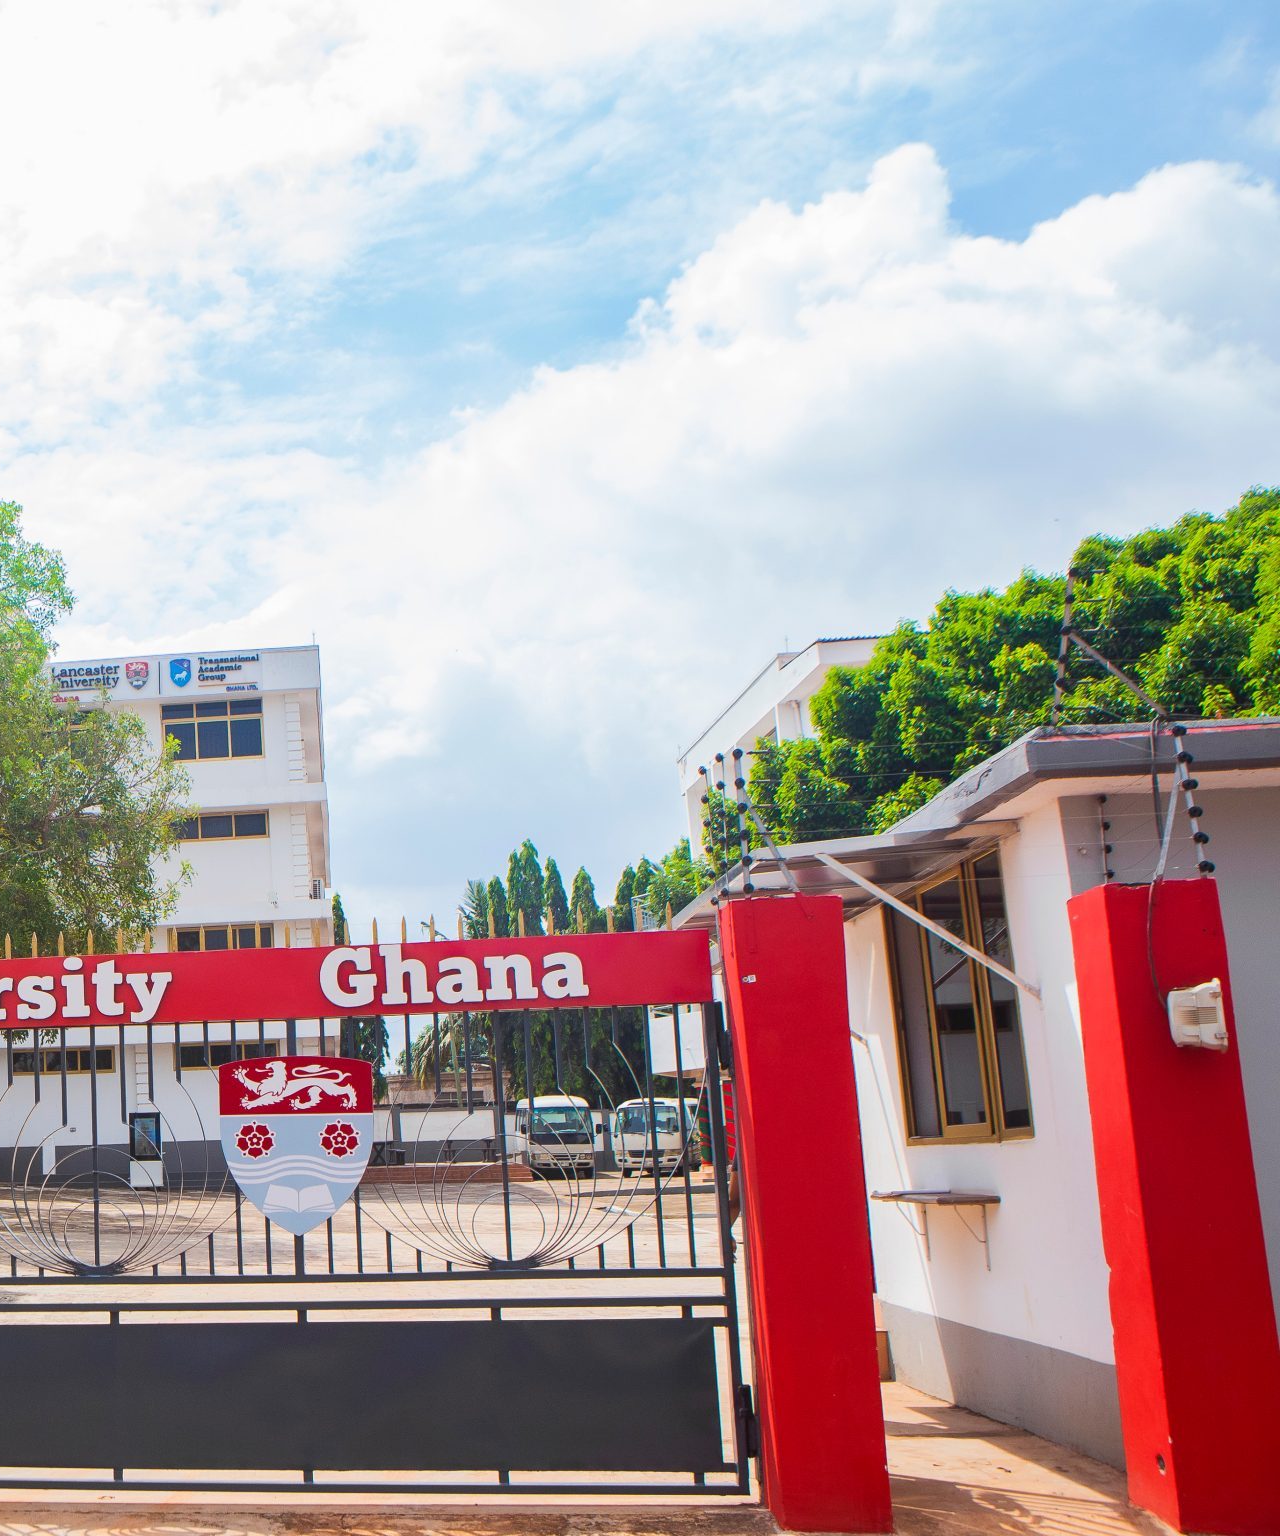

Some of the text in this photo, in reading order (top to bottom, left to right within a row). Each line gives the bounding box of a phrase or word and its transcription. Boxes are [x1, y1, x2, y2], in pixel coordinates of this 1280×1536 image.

[197, 653, 260, 665] Transnational
[51, 663, 120, 678] Lancaster
[197, 663, 243, 673] Academic
[197, 673, 227, 682] Group
[319, 943, 591, 1009] Ghana
